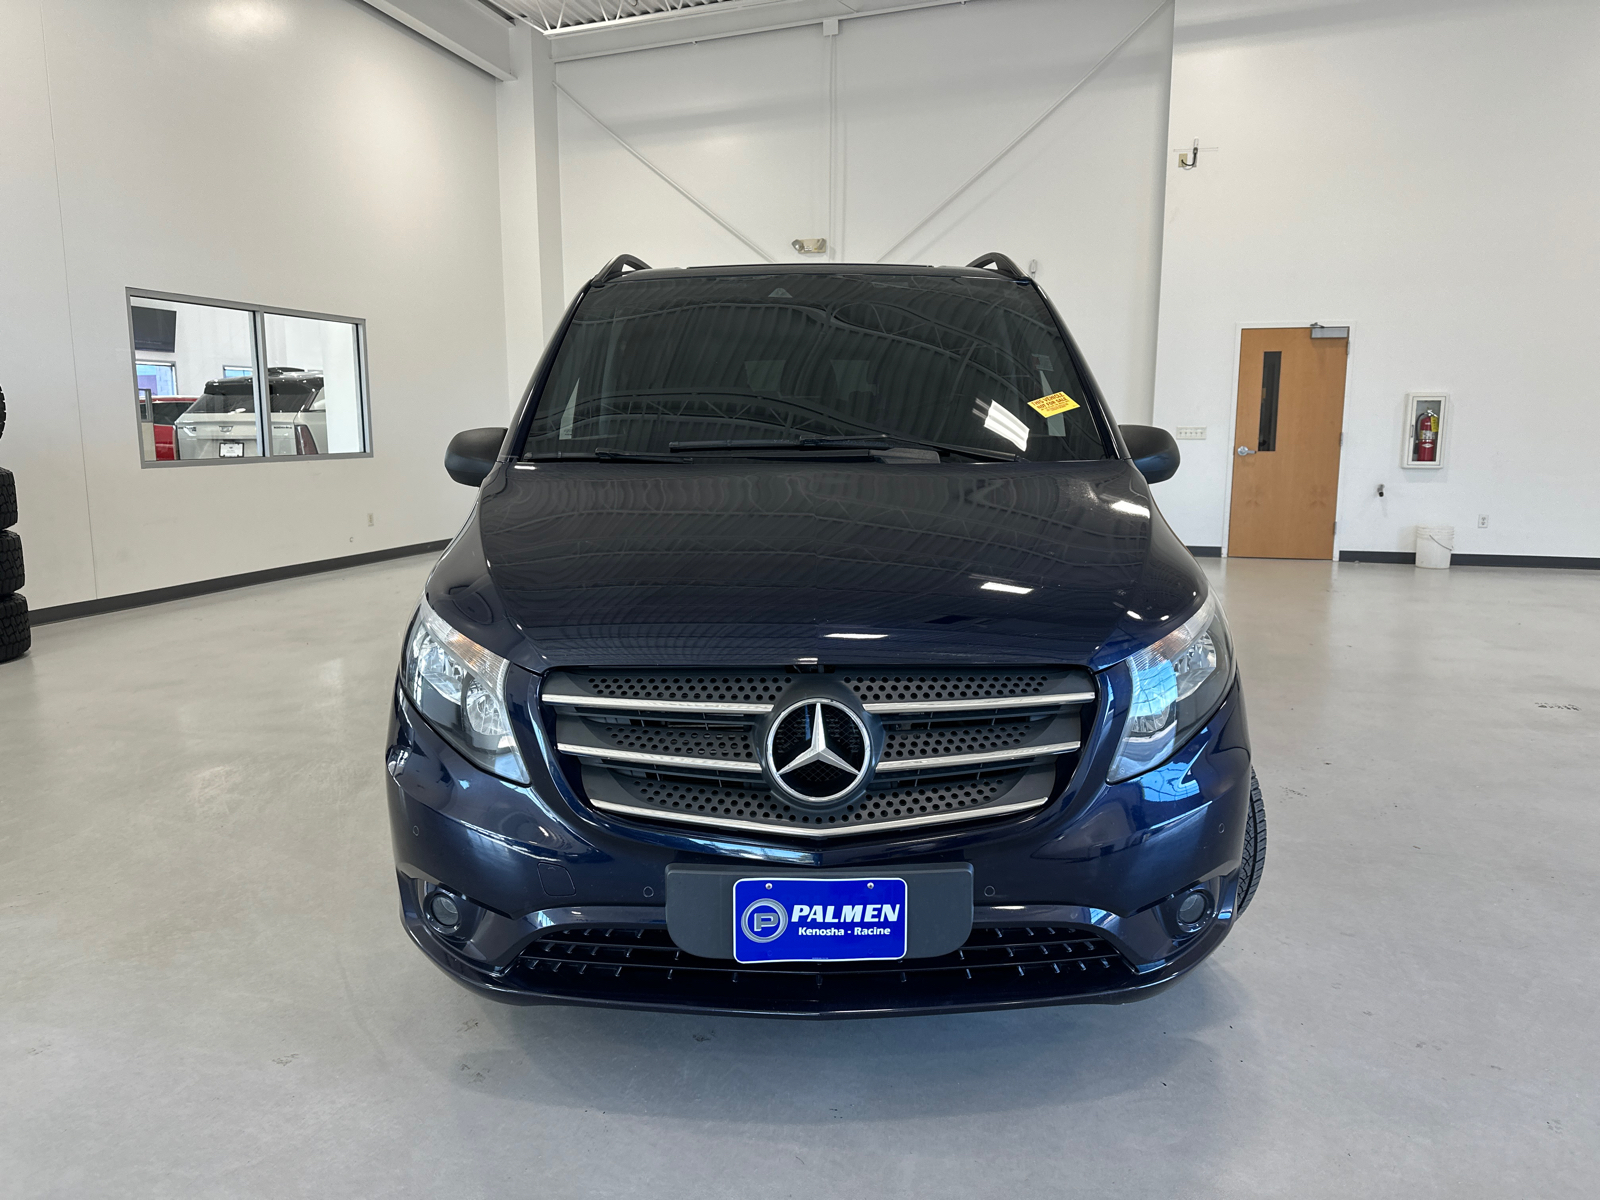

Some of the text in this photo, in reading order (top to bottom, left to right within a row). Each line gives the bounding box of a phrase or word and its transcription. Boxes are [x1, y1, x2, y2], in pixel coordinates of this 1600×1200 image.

[1044, 393, 1065, 401] VEHICLE
[791, 904, 900, 922] PALMEN
[753, 912, 779, 932] P
[798, 927, 845, 936] Kenosha
[854, 926, 891, 936] Racine
